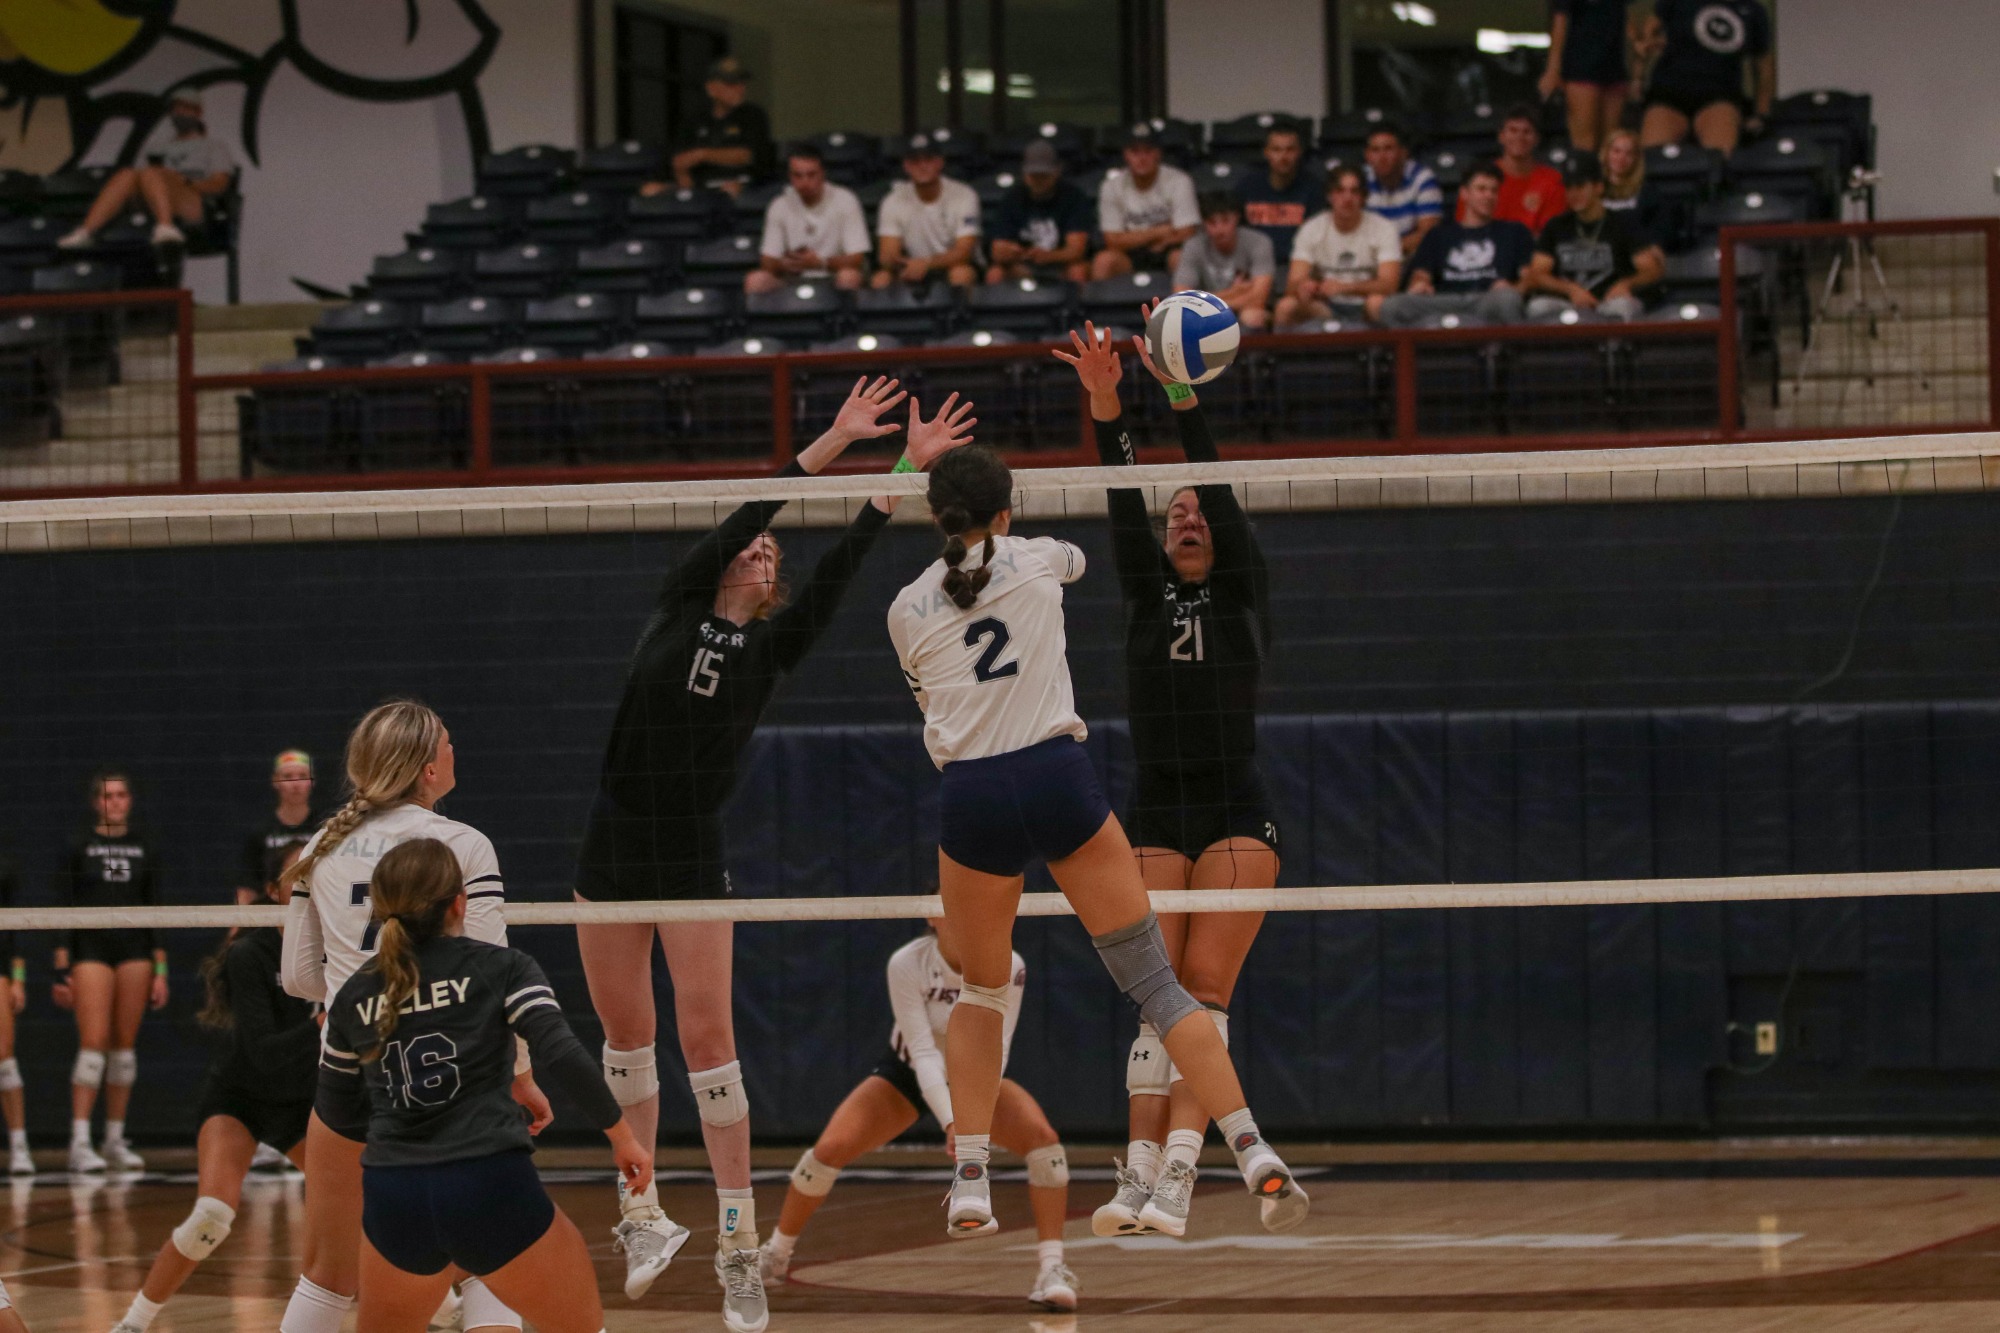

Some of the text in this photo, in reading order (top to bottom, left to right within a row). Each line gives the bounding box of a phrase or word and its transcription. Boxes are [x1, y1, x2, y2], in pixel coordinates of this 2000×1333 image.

[962, 615, 1020, 685] 2
[1170, 615, 1203, 660] 21
[687, 647, 724, 697] 15
[1265, 822, 1277, 844] 21
[349, 881, 384, 952] 7
[381, 1032, 461, 1108] 16
